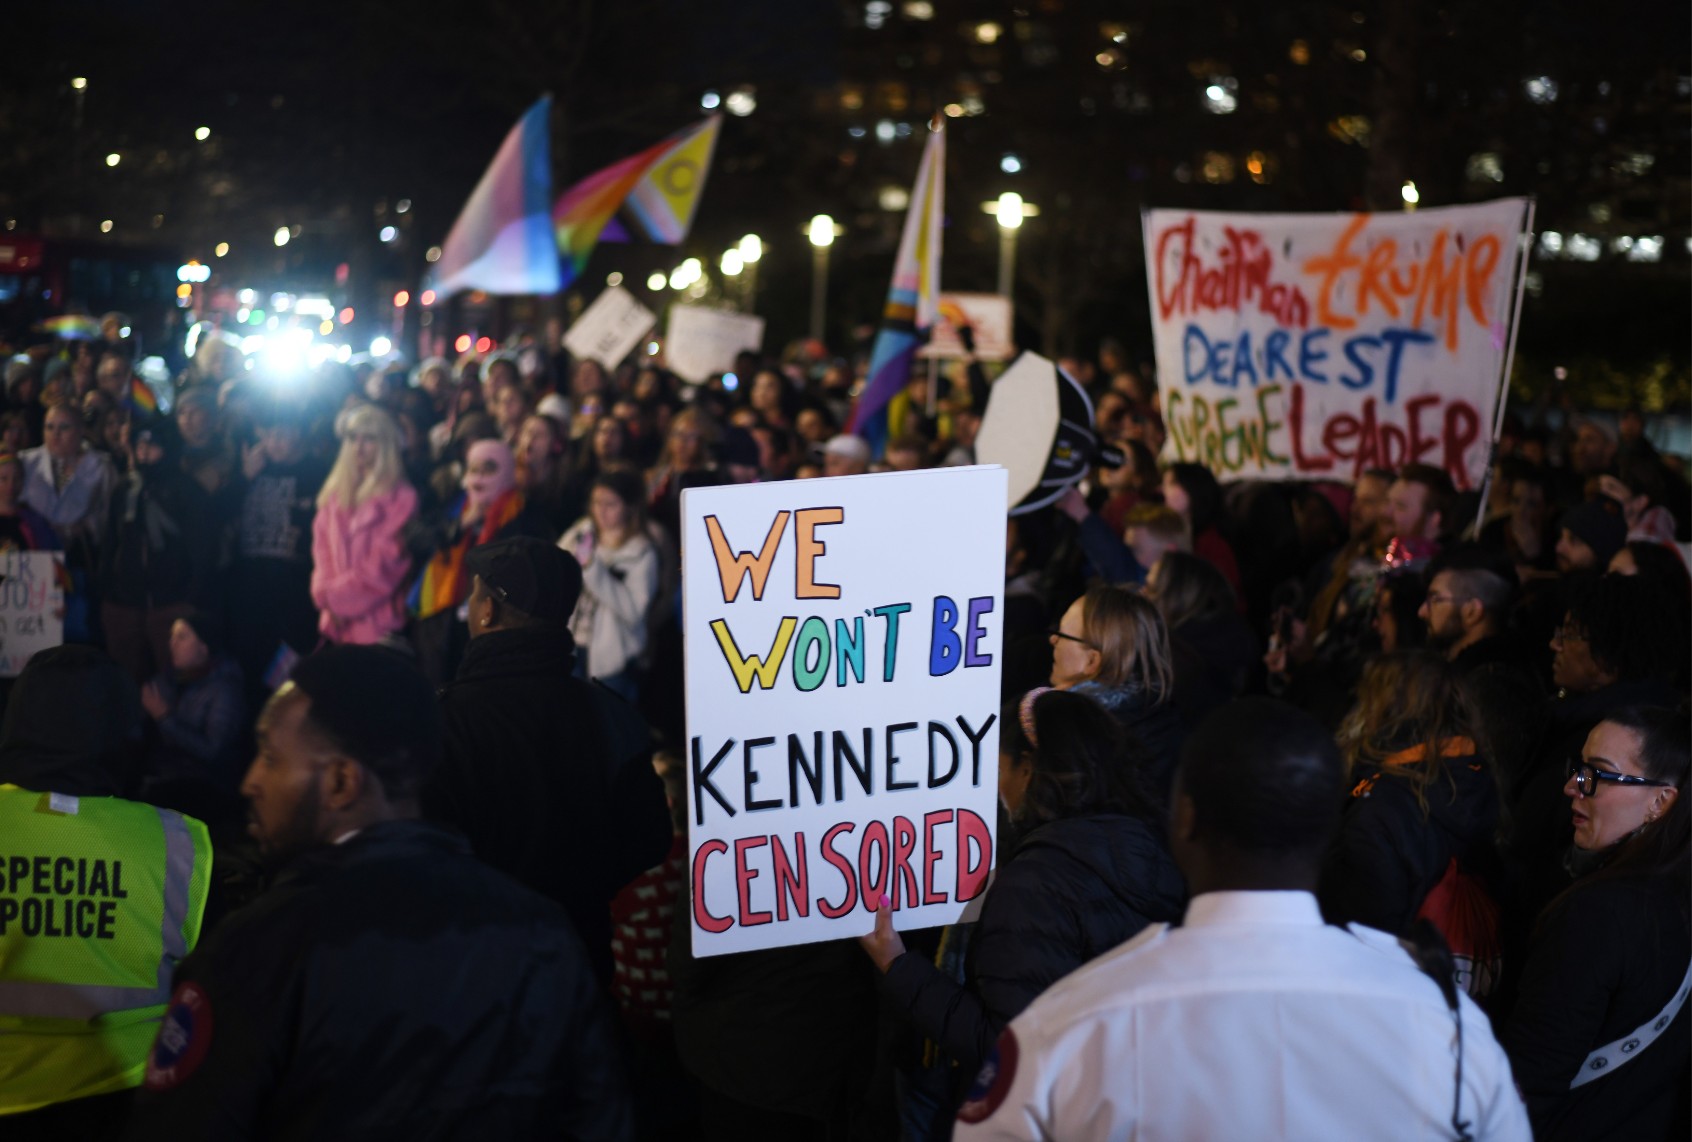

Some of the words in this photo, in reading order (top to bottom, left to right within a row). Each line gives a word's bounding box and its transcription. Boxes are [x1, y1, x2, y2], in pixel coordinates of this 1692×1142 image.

[1183, 322, 1435, 404] DEAREST
[703, 506, 844, 604] WE
[709, 602, 912, 693] WON'T
[929, 595, 994, 677] BE
[691, 713, 997, 826] KENNEDY
[0, 856, 128, 898] PECIAL
[0, 898, 117, 939] POLICE
[692, 808, 993, 933] CENSORED
